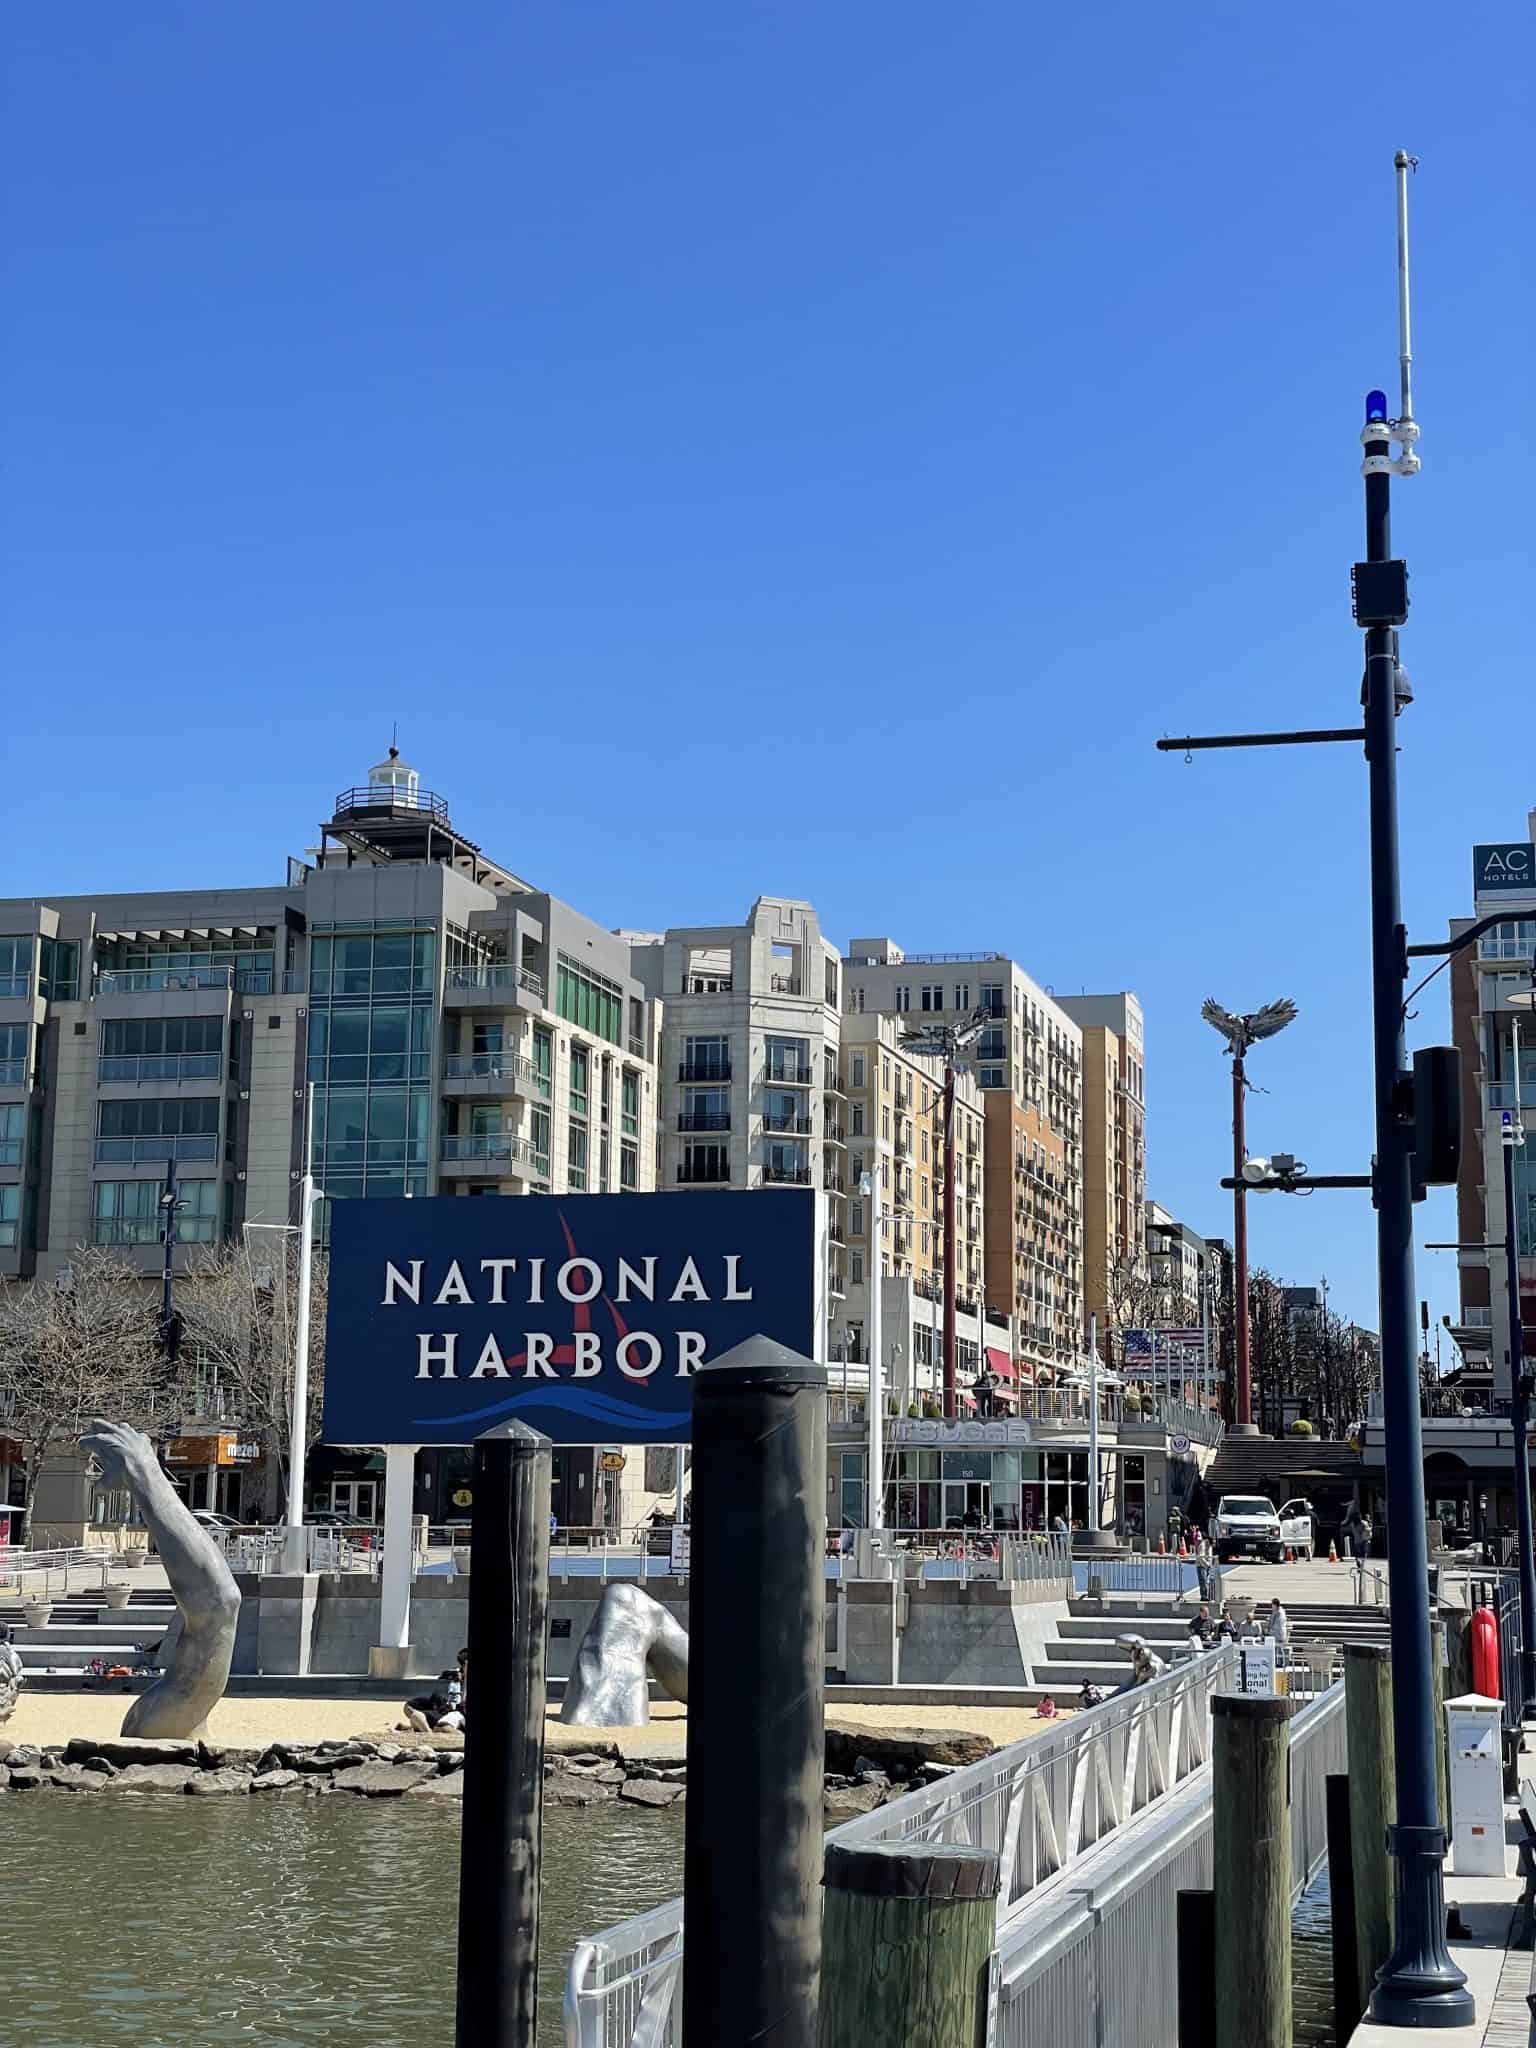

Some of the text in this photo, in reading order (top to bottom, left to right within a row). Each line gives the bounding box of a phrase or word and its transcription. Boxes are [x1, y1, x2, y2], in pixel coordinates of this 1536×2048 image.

[1484, 850, 1528, 872] AC
[1484, 873, 1529, 881] HOTELS
[380, 1256, 753, 1305] NATIONAL
[414, 1331, 707, 1379] HARBOR
[227, 1441, 260, 1458] mezeh
